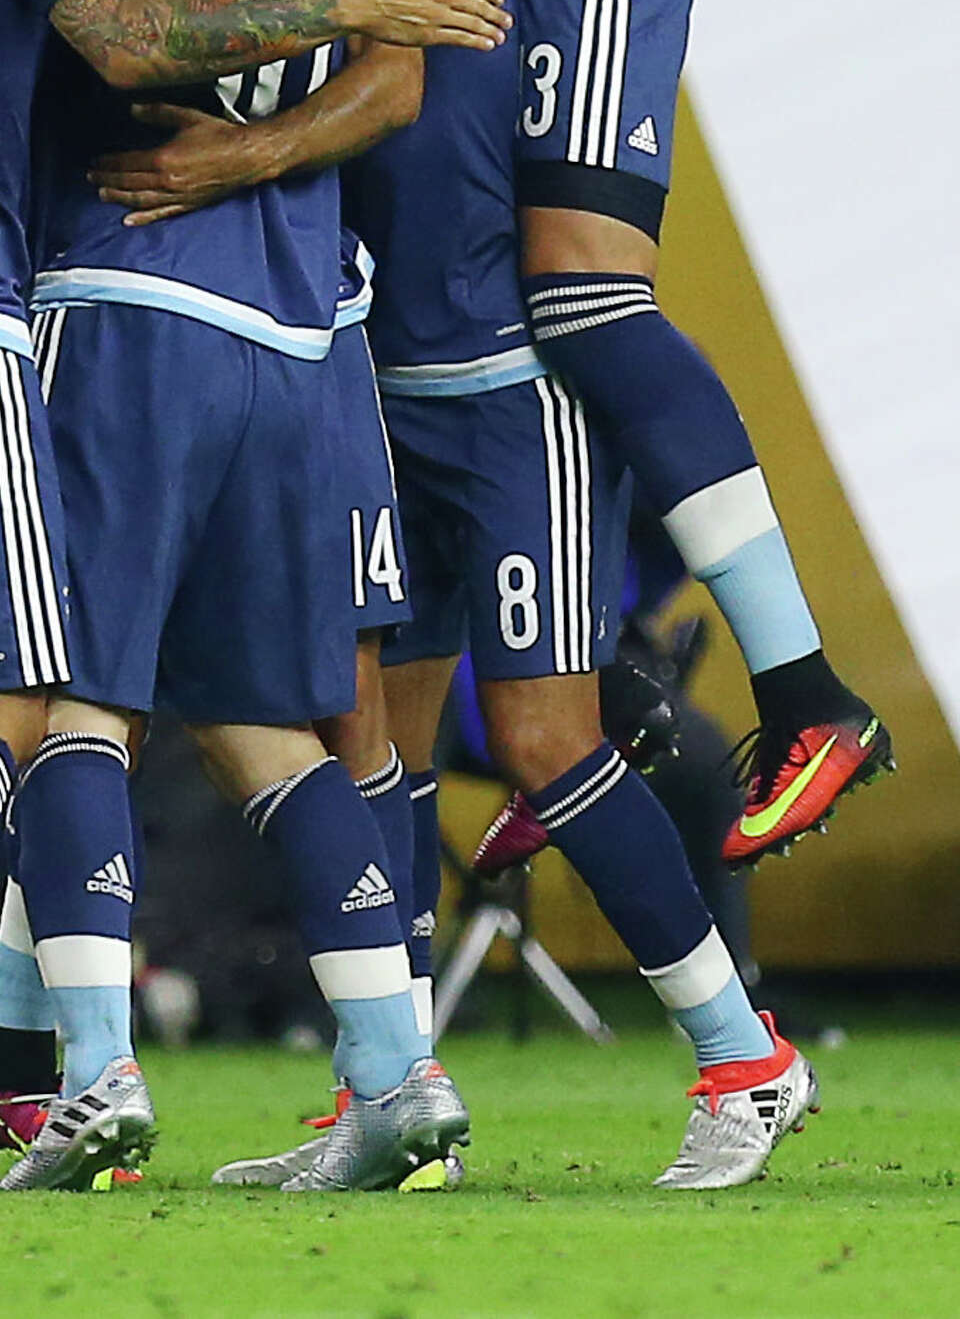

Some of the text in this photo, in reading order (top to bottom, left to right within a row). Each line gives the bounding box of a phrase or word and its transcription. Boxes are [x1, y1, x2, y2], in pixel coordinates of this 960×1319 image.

[515, 43, 562, 138] 3
[351, 507, 405, 607] 14
[497, 554, 539, 650] 8
